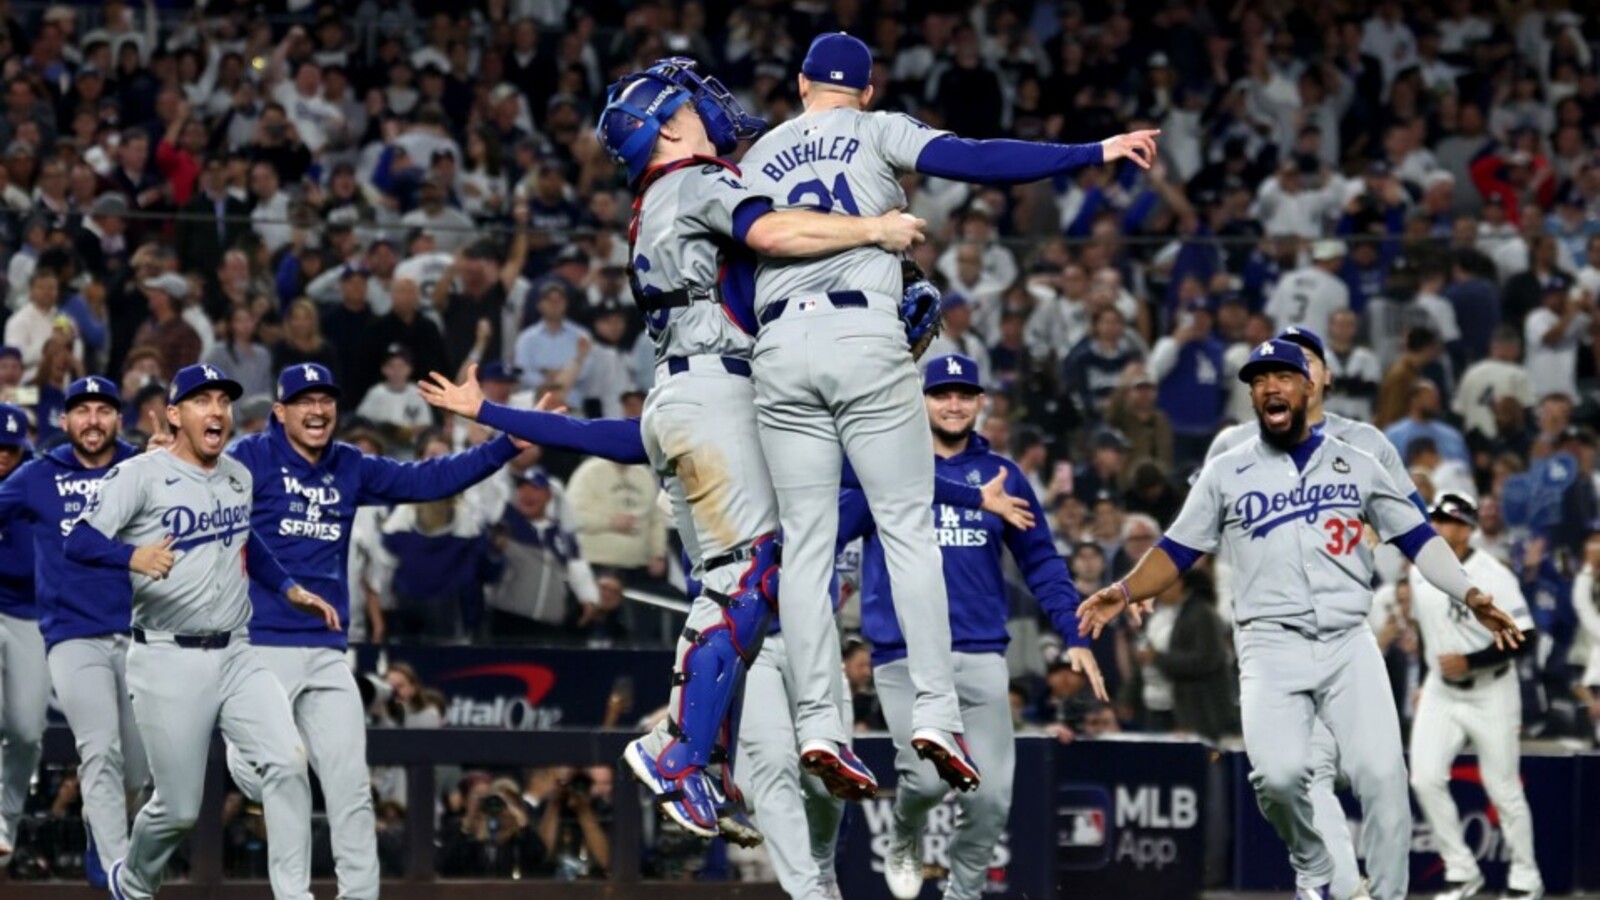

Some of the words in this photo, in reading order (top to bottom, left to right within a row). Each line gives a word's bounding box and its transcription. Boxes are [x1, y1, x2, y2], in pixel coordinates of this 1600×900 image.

[762, 136, 860, 182] BUEHLER
[201, 364, 219, 381] LA
[302, 365, 319, 381] LA
[946, 357, 962, 375] LA
[86, 376, 100, 393] LA
[64, 502, 81, 513] 20
[289, 501, 304, 513] 20
[1235, 477, 1362, 530] Dodgers
[939, 503, 961, 528] LA
[964, 510, 983, 521] 24
[60, 519, 81, 537] S
[279, 518, 342, 542] SERIES
[1324, 518, 1365, 556] 37
[1115, 784, 1198, 828] MLB
[1115, 831, 1177, 871] App
